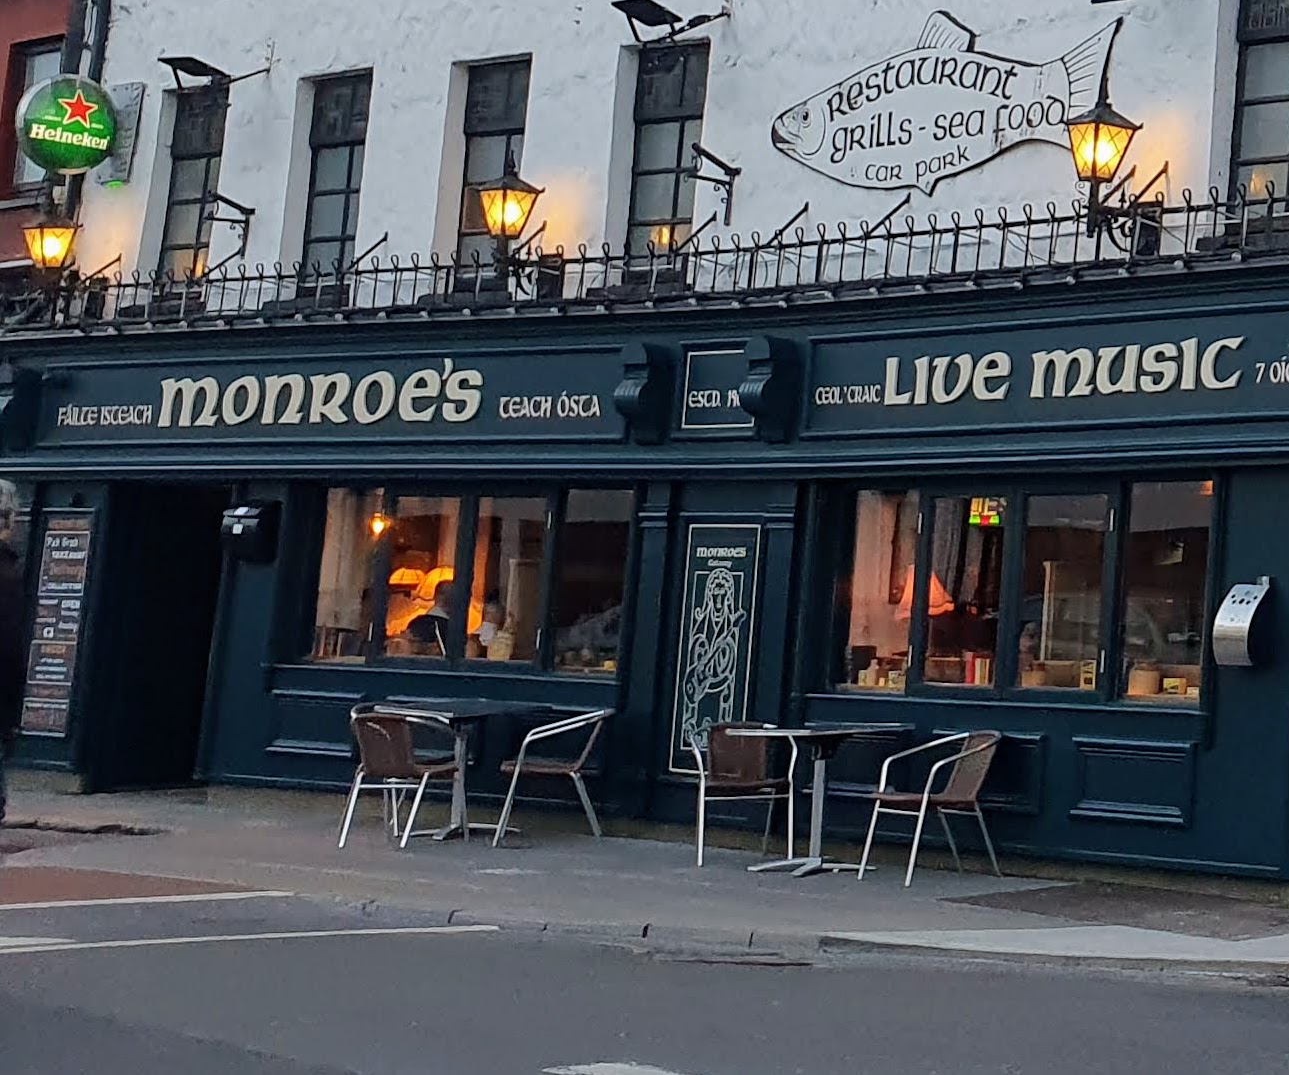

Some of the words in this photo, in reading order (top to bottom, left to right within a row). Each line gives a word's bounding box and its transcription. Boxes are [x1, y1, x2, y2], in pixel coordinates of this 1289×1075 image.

[30, 123, 110, 150] Heineken
[830, 112, 912, 164] grills
[932, 108, 986, 140] sea
[883, 351, 1012, 406] LIVE
[1030, 336, 1247, 398] MUSIC
[1254, 362, 1266, 384] 7
[100, 404, 153, 426] ISTEACH
[499, 395, 552, 419] TEACH
[557, 390, 601, 418] ÓSTA
